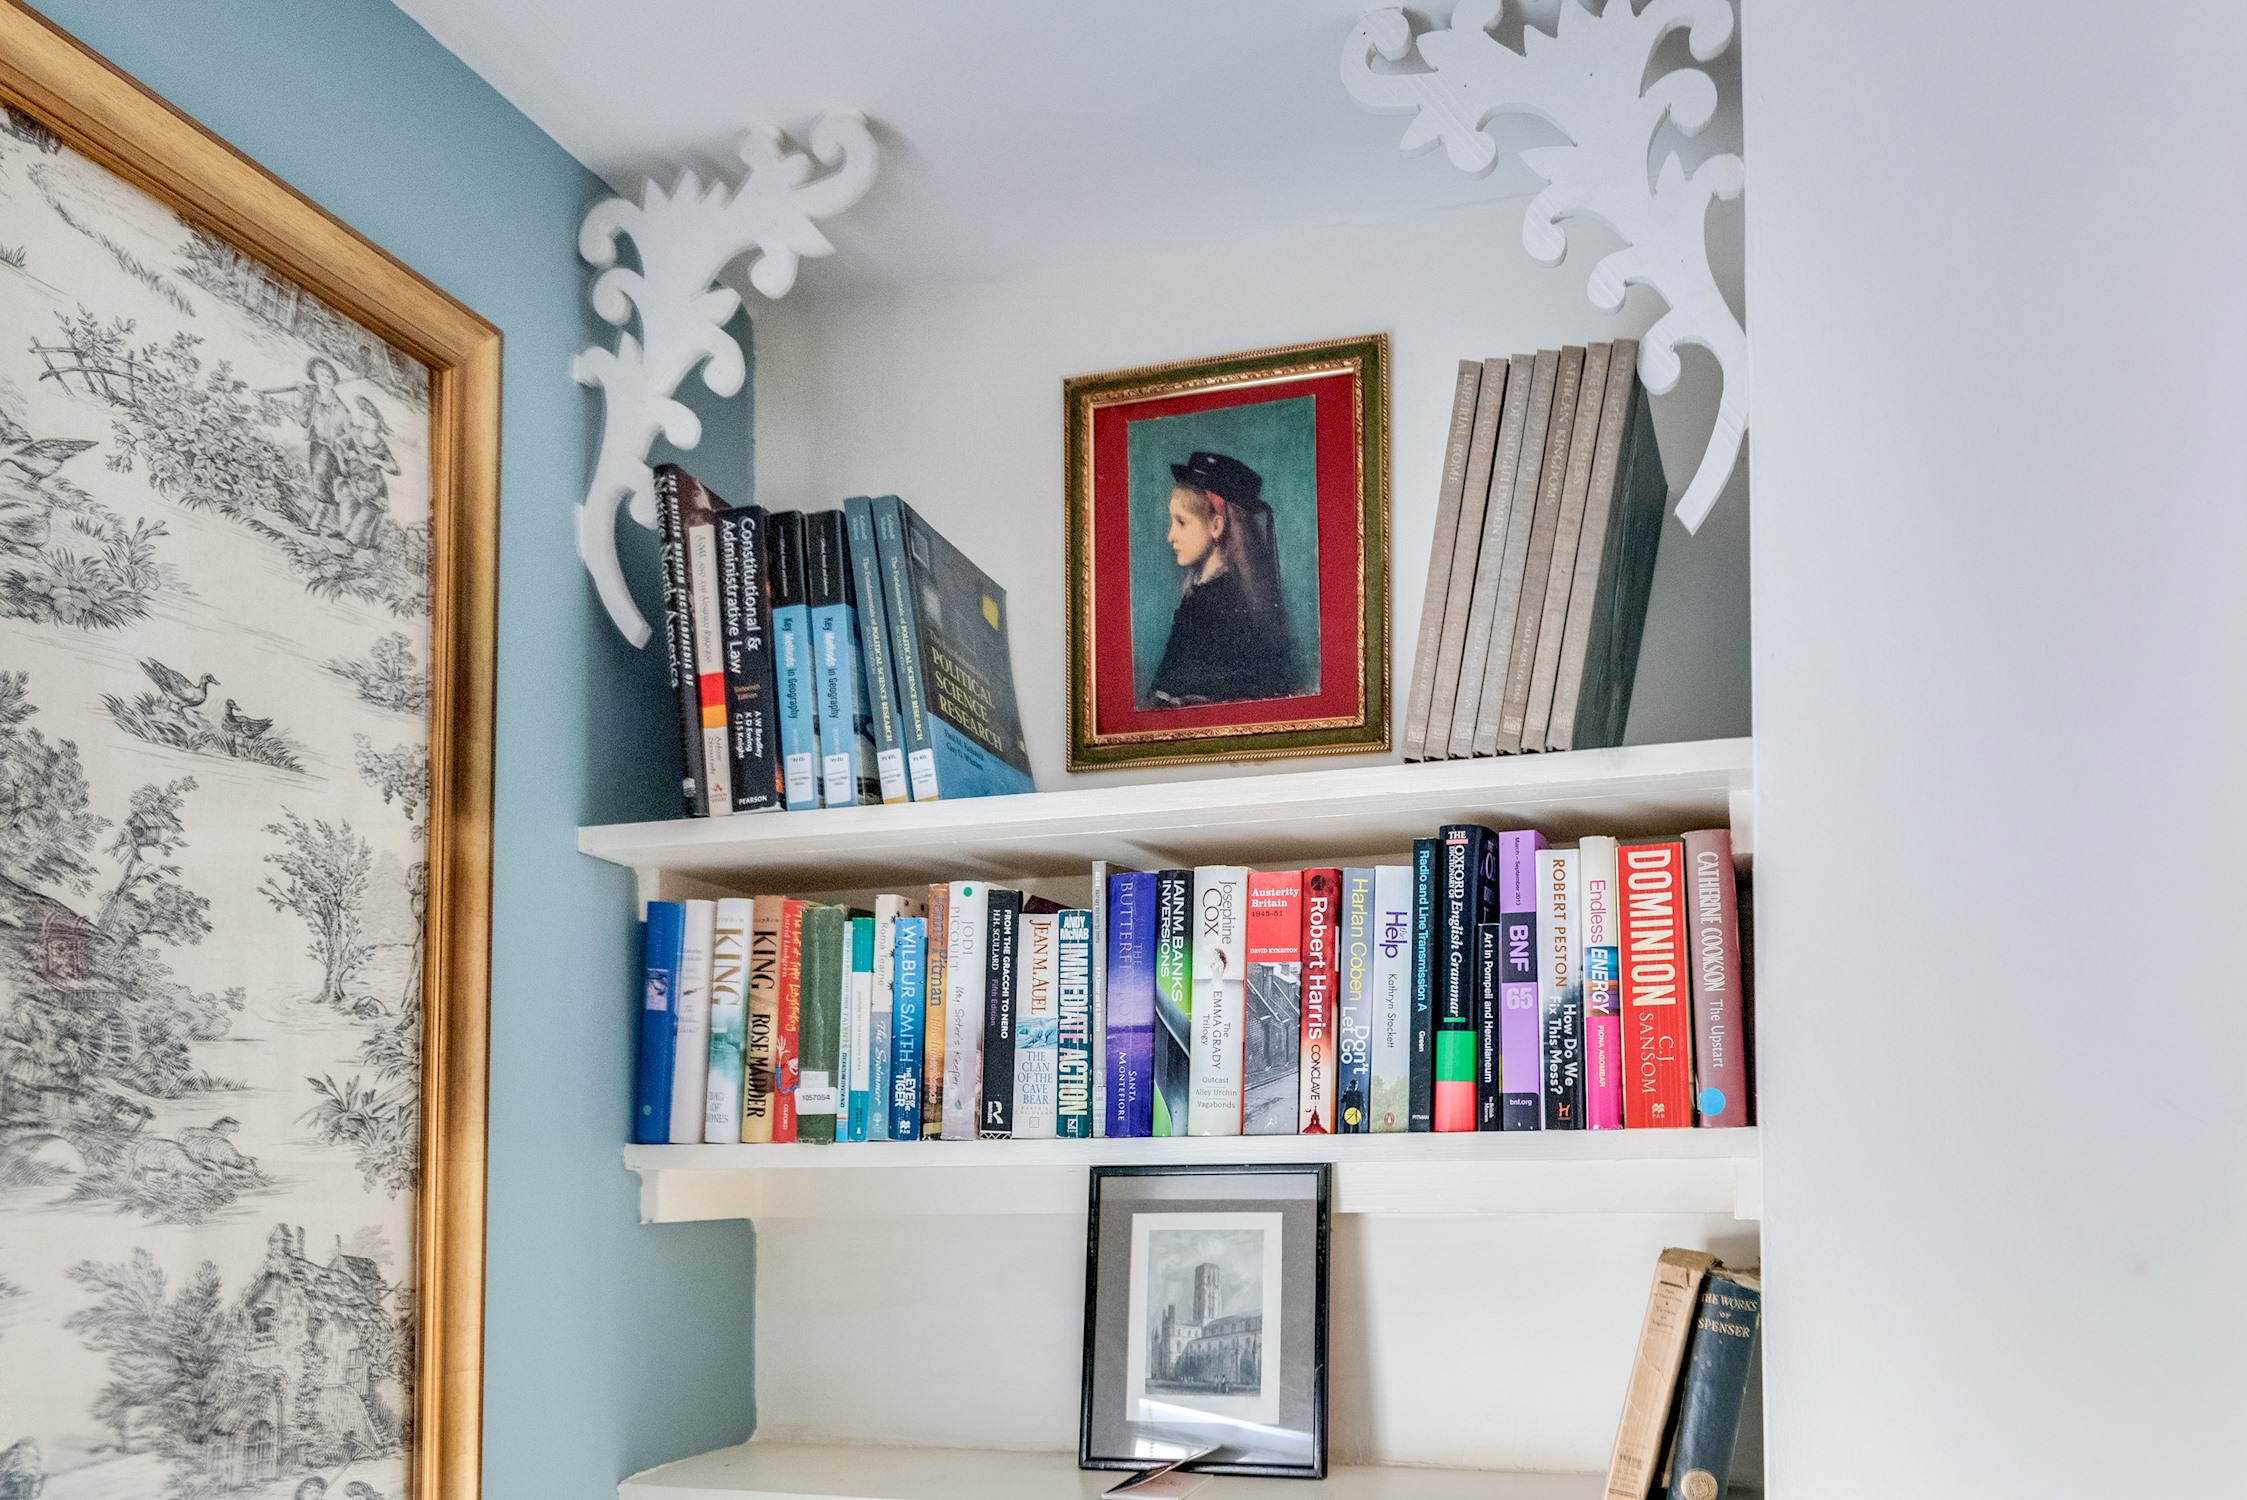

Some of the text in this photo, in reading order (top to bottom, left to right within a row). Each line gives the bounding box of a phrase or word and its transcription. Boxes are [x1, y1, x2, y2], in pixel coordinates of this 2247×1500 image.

[1448, 373, 1475, 484] IMPERIAL ROME
[1545, 360, 1577, 507] AFRICAN KINGDOMS
[674, 542, 686, 584] MUSEUM
[741, 515, 763, 652] Constitutional &
[659, 543, 681, 688] North America
[722, 519, 743, 674] Administrative Law
[782, 617, 794, 632] Key
[822, 617, 834, 632] Key
[824, 631, 838, 667] Methods
[871, 627, 883, 667] POLITICAL
[902, 626, 914, 666] POLITICAL
[786, 676, 799, 719] Geography
[827, 676, 841, 719] Geography
[877, 669, 888, 701] SCIENCE
[906, 667, 918, 699] SCIENCE
[931, 646, 997, 709] POLITICAL
[935, 670, 990, 723] SCIENCE
[736, 731, 745, 759] Knight
[745, 726, 753, 752] Ewing
[754, 727, 763, 758] Bradley
[881, 701, 894, 742] RESEARCH
[911, 700, 924, 741] RESEARCH
[938, 693, 1004, 752] RESEARCH
[738, 795, 768, 806] PEARSON
[1448, 831, 1466, 839] THE
[1251, 887, 1299, 899] Austerity
[1454, 845, 1465, 899] OXFORD
[1063, 916, 1086, 928] ANDY
[1218, 880, 1237, 945] Josephine
[1251, 898, 1288, 907] Britain
[1552, 859, 1567, 988] ROBERT PESTON
[1589, 879, 1606, 944] Endless
[1627, 848, 1676, 1007] DOMINION
[1697, 851, 1725, 992] CATHERINE COOKSON
[781, 912, 793, 978] Astrid Lindgren
[878, 922, 889, 987] Roma Tearne
[930, 896, 948, 1007] Jenny Pitman
[949, 906, 960, 971] PICOULT
[962, 919, 975, 955] JODI
[991, 909, 1001, 971] H.H. SCULLARD
[1060, 928, 1089, 941] McNAB
[1118, 882, 1134, 981] BUTTERFLY
[1133, 942, 1142, 966] THE
[1161, 880, 1171, 978] INVERSIONS
[1172, 880, 1185, 1002] IAIN M. BANKS
[1349, 878, 1369, 1001] Harlan Coben
[1379, 911, 1408, 959] Help
[1417, 850, 1430, 1013] Radio and Line Transmission A
[1509, 924, 1530, 972] BNF
[711, 928, 744, 1006] KING
[751, 930, 777, 990] KING
[1000, 909, 1012, 1039] FROM THE GRACCHI TO NERO
[1030, 920, 1051, 1015] JEAN M. AUEL
[1308, 897, 1328, 1040] Robert Harris
[1448, 900, 1464, 1018] English Grammar
[1591, 948, 1610, 1015] ENERGY
[899, 925, 917, 1062] WILBUR SMITH
[990, 978, 999, 1026] Fifth Edition
[1386, 973, 1399, 1049] Kathryn Stockett
[1483, 932, 1494, 1083] Art in Pompeii and Herculaneum
[1506, 987, 1533, 1010] 65
[948, 985, 965, 1087] My Sister's Keeper
[1058, 943, 1089, 1115] IMMEDIATE ACTION
[1200, 1014, 1210, 1045] Trilogy
[1212, 990, 1222, 1069] EMMA GRADY
[1223, 1022, 1231, 1038] The
[1340, 1005, 1357, 1065] Let Go
[1353, 1024, 1370, 1075] Don't
[1418, 1030, 1426, 1053] Green
[1549, 996, 1564, 1095] Fix This Mess?
[1563, 1004, 1578, 1087] How Do We
[1639, 1012, 1656, 1094] SANSOM
[1658, 1035, 1674, 1067] C.J.
[1709, 999, 1724, 1068] The Upstart
[747, 1013, 771, 1118] ROSE MADDER
[874, 1020, 888, 1106] The Swimmer
[1017, 1073, 1053, 1083] OF THE
[1021, 1062, 1050, 1072] CLAN
[1027, 1051, 1046, 1062] THE
[1201, 1076, 1230, 1084] Outcast
[1310, 1044, 1322, 1101] CONCLAVE
[1597, 1025, 1606, 1088] FIONA AGOMBAR
[709, 1091, 725, 1101] BAG
[709, 1102, 722, 1112] OF
[801, 1093, 831, 1101] 1057054
[894, 1073, 906, 1107] TIGER
[905, 1078, 916, 1100] EYE
[1022, 1084, 1048, 1094] CAVE
[1023, 1095, 1049, 1105] BEAR
[1117, 1051, 1127, 1121] MONTEFIORE
[1128, 1071, 1137, 1102] SANTA
[1195, 1088, 1237, 1097] Alley Urchin
[1197, 1101, 1236, 1109] Vagabonds
[1697, 1318, 1751, 1338] SPENSER
[1721, 1295, 1758, 1312] WORKS
